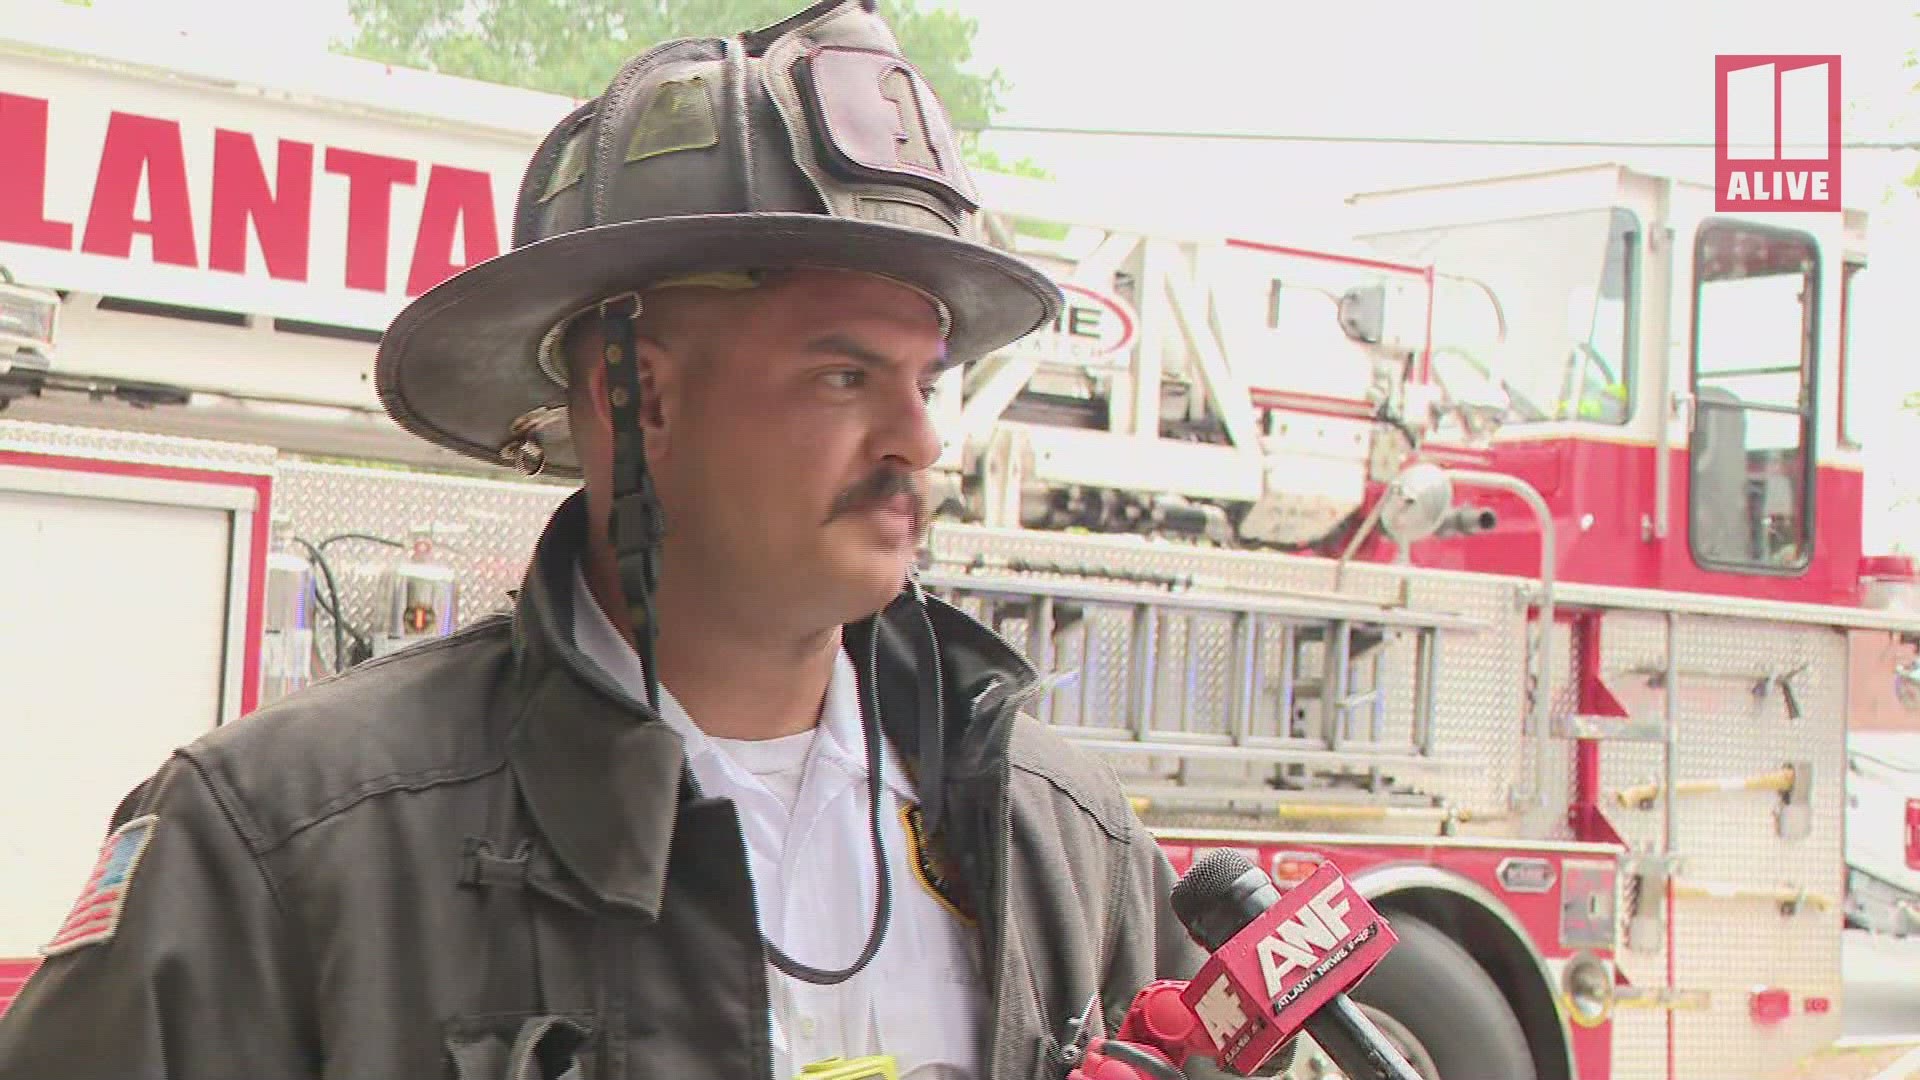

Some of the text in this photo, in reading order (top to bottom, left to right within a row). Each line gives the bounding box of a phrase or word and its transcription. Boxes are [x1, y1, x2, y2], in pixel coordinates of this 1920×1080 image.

[878, 66, 943, 174] 1
[0, 91, 500, 297] LANTA
[1256, 877, 1351, 999] ANF
